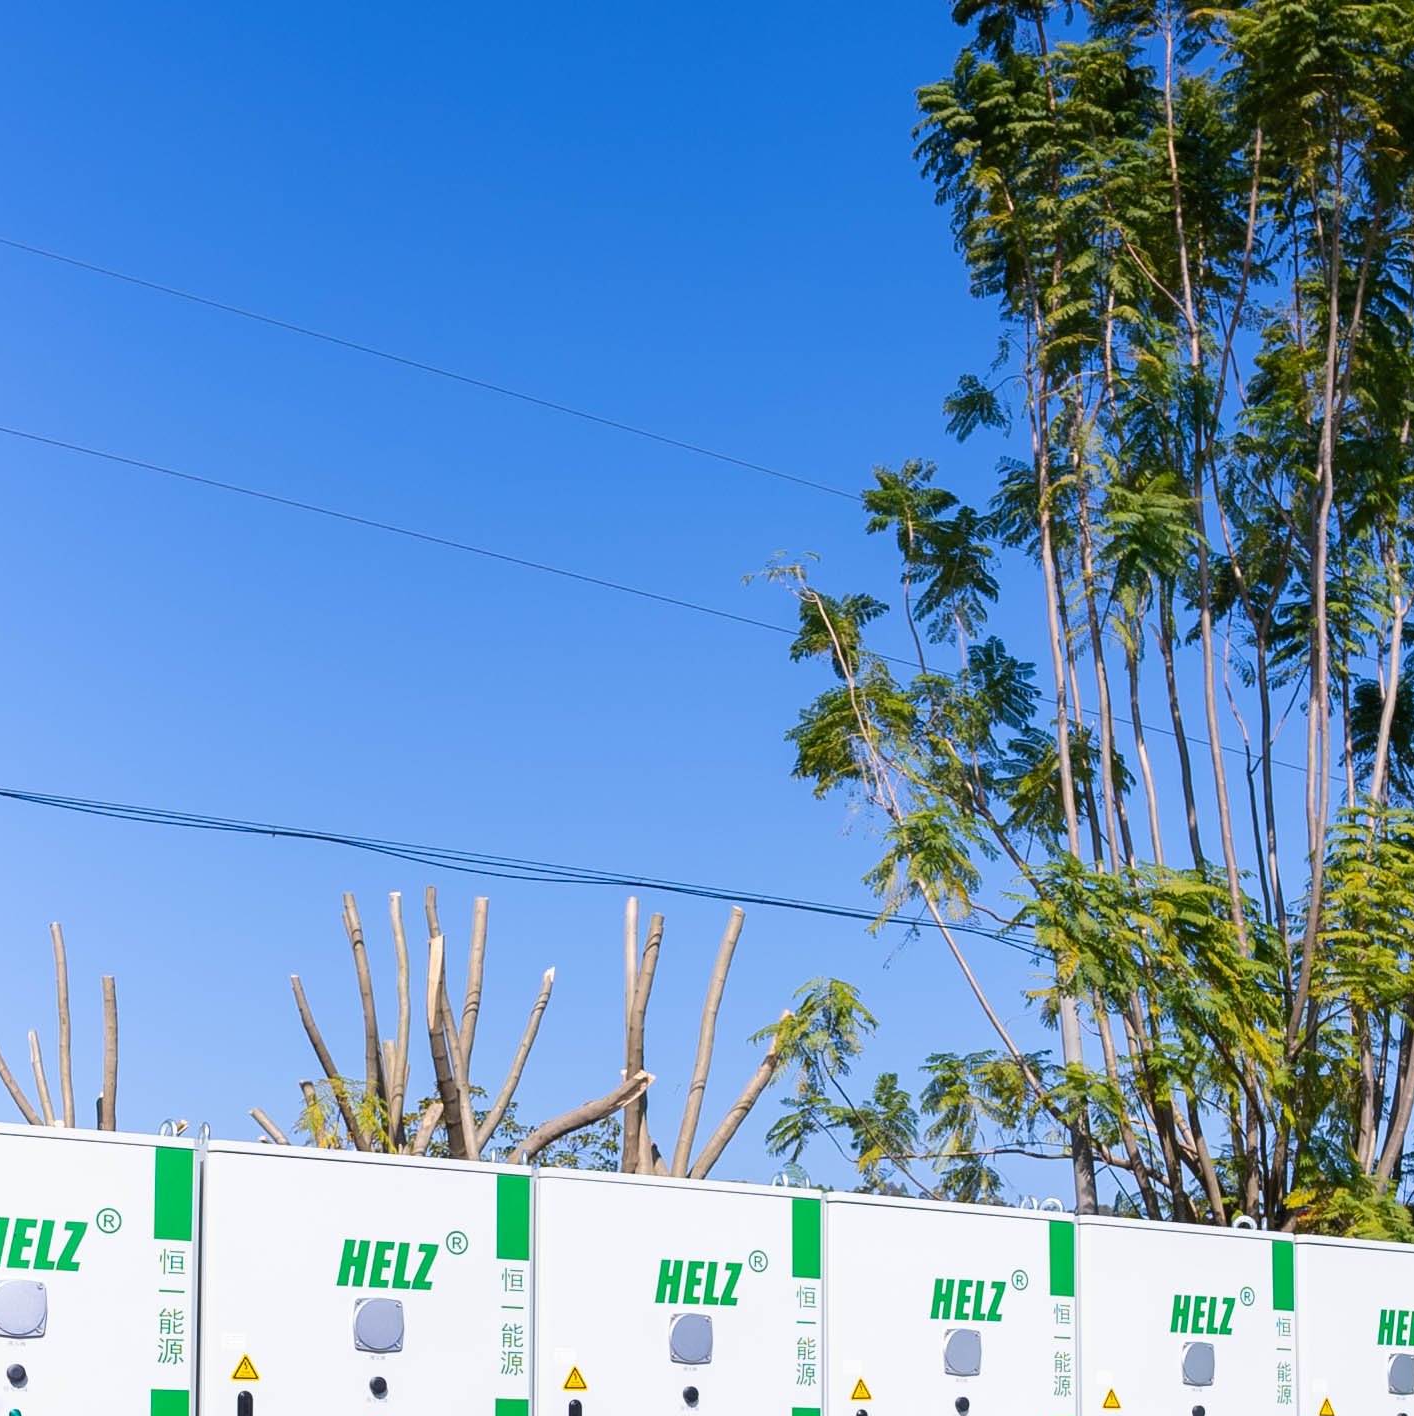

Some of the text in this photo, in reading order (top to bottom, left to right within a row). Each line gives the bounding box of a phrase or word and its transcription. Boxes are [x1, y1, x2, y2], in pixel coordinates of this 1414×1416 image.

[336, 1238, 439, 1291] HELZ
[655, 1258, 743, 1307] HELZ
[930, 1277, 1006, 1323] HELZ
[157, 1248, 186, 1365] 恒一能源
[500, 1267, 525, 1377] 恒一能源
[795, 1284, 818, 1387] 恒一能源
[1170, 1293, 1236, 1336] HELZ
[1053, 1303, 1072, 1398] 恒一能源
